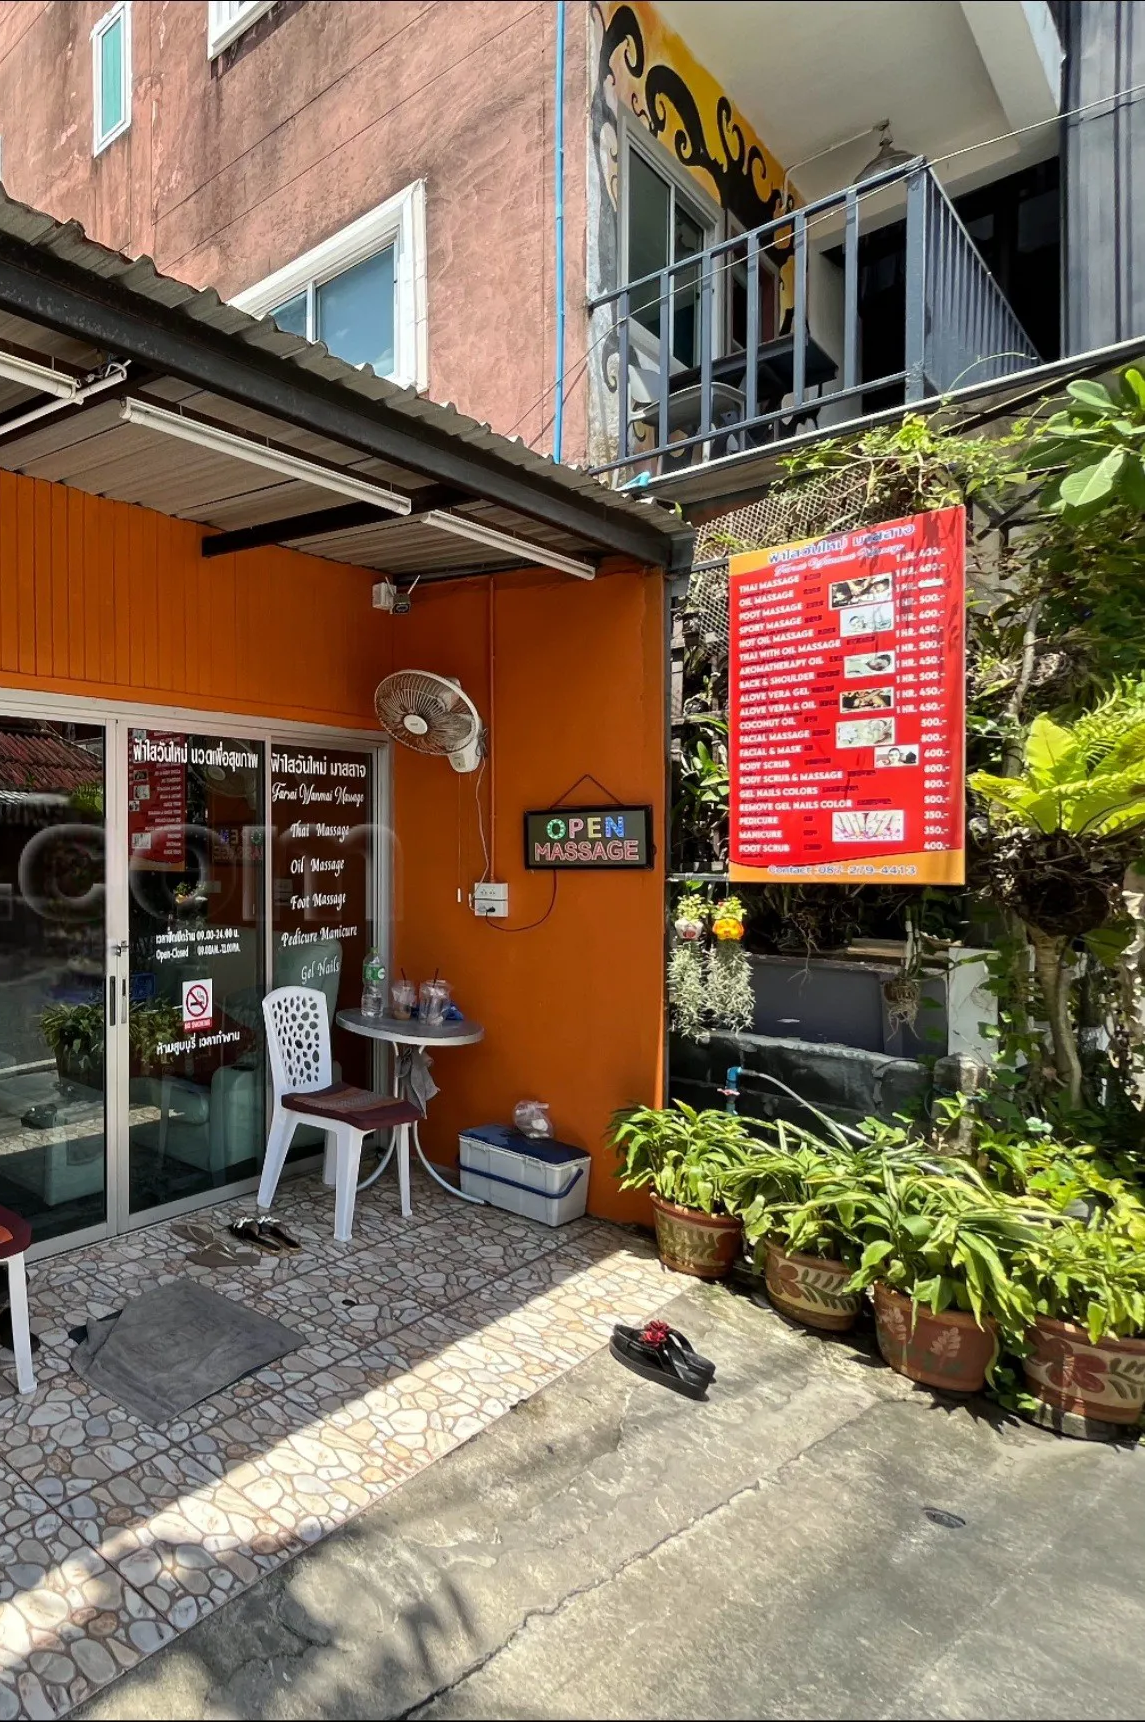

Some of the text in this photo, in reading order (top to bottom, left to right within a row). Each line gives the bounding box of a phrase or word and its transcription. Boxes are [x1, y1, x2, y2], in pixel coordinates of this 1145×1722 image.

[739, 583, 757, 593] THAI
[759, 575, 800, 589] MASSAGE
[739, 598, 752, 607] OIL
[754, 590, 794, 604] MASSAGE
[739, 610, 761, 620] FOOT
[762, 602, 803, 616] MASSAGE
[739, 623, 764, 635] SPORT
[757, 636, 771, 645] OIL
[773, 629, 813, 643] MASSAGE
[739, 652, 757, 661] THAI
[759, 649, 781, 658] WITH
[782, 646, 796, 655] OIL
[798, 639, 841, 653] MASSAGE
[739, 659, 807, 675] AROMATHERAPY
[808, 656, 824, 666] OIL
[739, 680, 760, 689] BACK
[762, 678, 769, 686] &
[771, 672, 814, 685] SHOULDER
[768, 690, 790, 699] VERA
[793, 687, 809, 696] GEL
[768, 703, 790, 713] VERA
[793, 702, 799, 710] &
[801, 701, 816, 709] OIL
[739, 717, 796, 729] COCONUT OIL
[739, 734, 767, 743] FACIAL
[769, 730, 810, 741] MASSAGE
[739, 749, 767, 757] FACIAL
[777, 745, 801, 754] MASK
[739, 760, 790, 770] BODY SCRUB
[739, 776, 761, 784] BODY
[763, 774, 790, 783] SCRUB
[800, 771, 843, 781] MASSAGE
[739, 789, 755, 798] GEL
[757, 788, 780, 797] NAILS
[783, 787, 818, 795] COLORS
[739, 803, 773, 812] REMOVE
[775, 802, 791, 810] GEL
[793, 801, 818, 809] NAILS
[821, 800, 852, 808] COLOR
[547, 816, 625, 839] OPEN
[739, 816, 778, 825] PEDICURE
[290, 820, 349, 843] Thai Massage
[739, 830, 782, 839] MANICURE
[535, 840, 639, 861] MASSAGE
[739, 844, 790, 852] FOOT SCRUB
[290, 856, 344, 877] Oil Massage
[767, 865, 812, 876] Contact
[290, 893, 346, 911] Foot Massage
[281, 925, 357, 947] Pedicure Manicure
[302, 961, 314, 985] Gel
[318, 956, 339, 976] Nails
